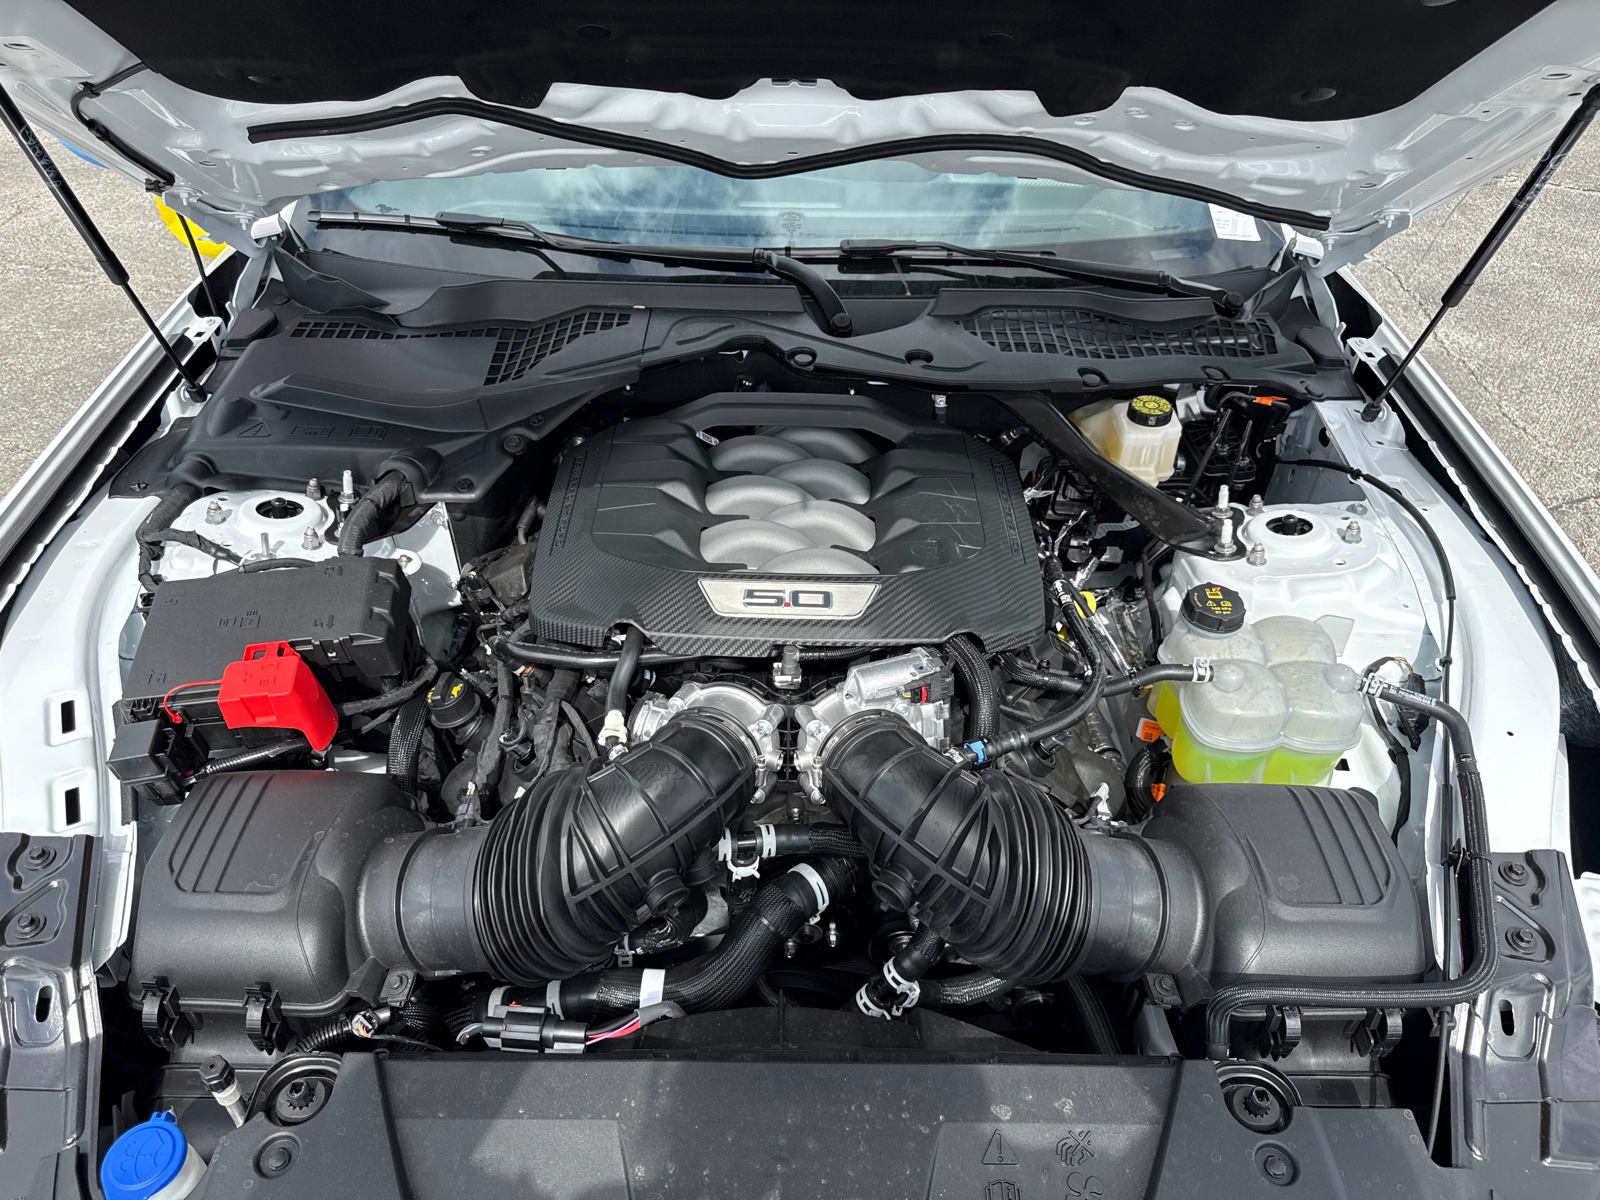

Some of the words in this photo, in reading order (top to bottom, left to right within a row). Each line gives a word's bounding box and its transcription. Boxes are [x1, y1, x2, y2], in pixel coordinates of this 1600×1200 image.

[994, 463, 1005, 488] FORD
[1003, 505, 1020, 557] POWERED
[743, 589, 833, 609] 5.0
